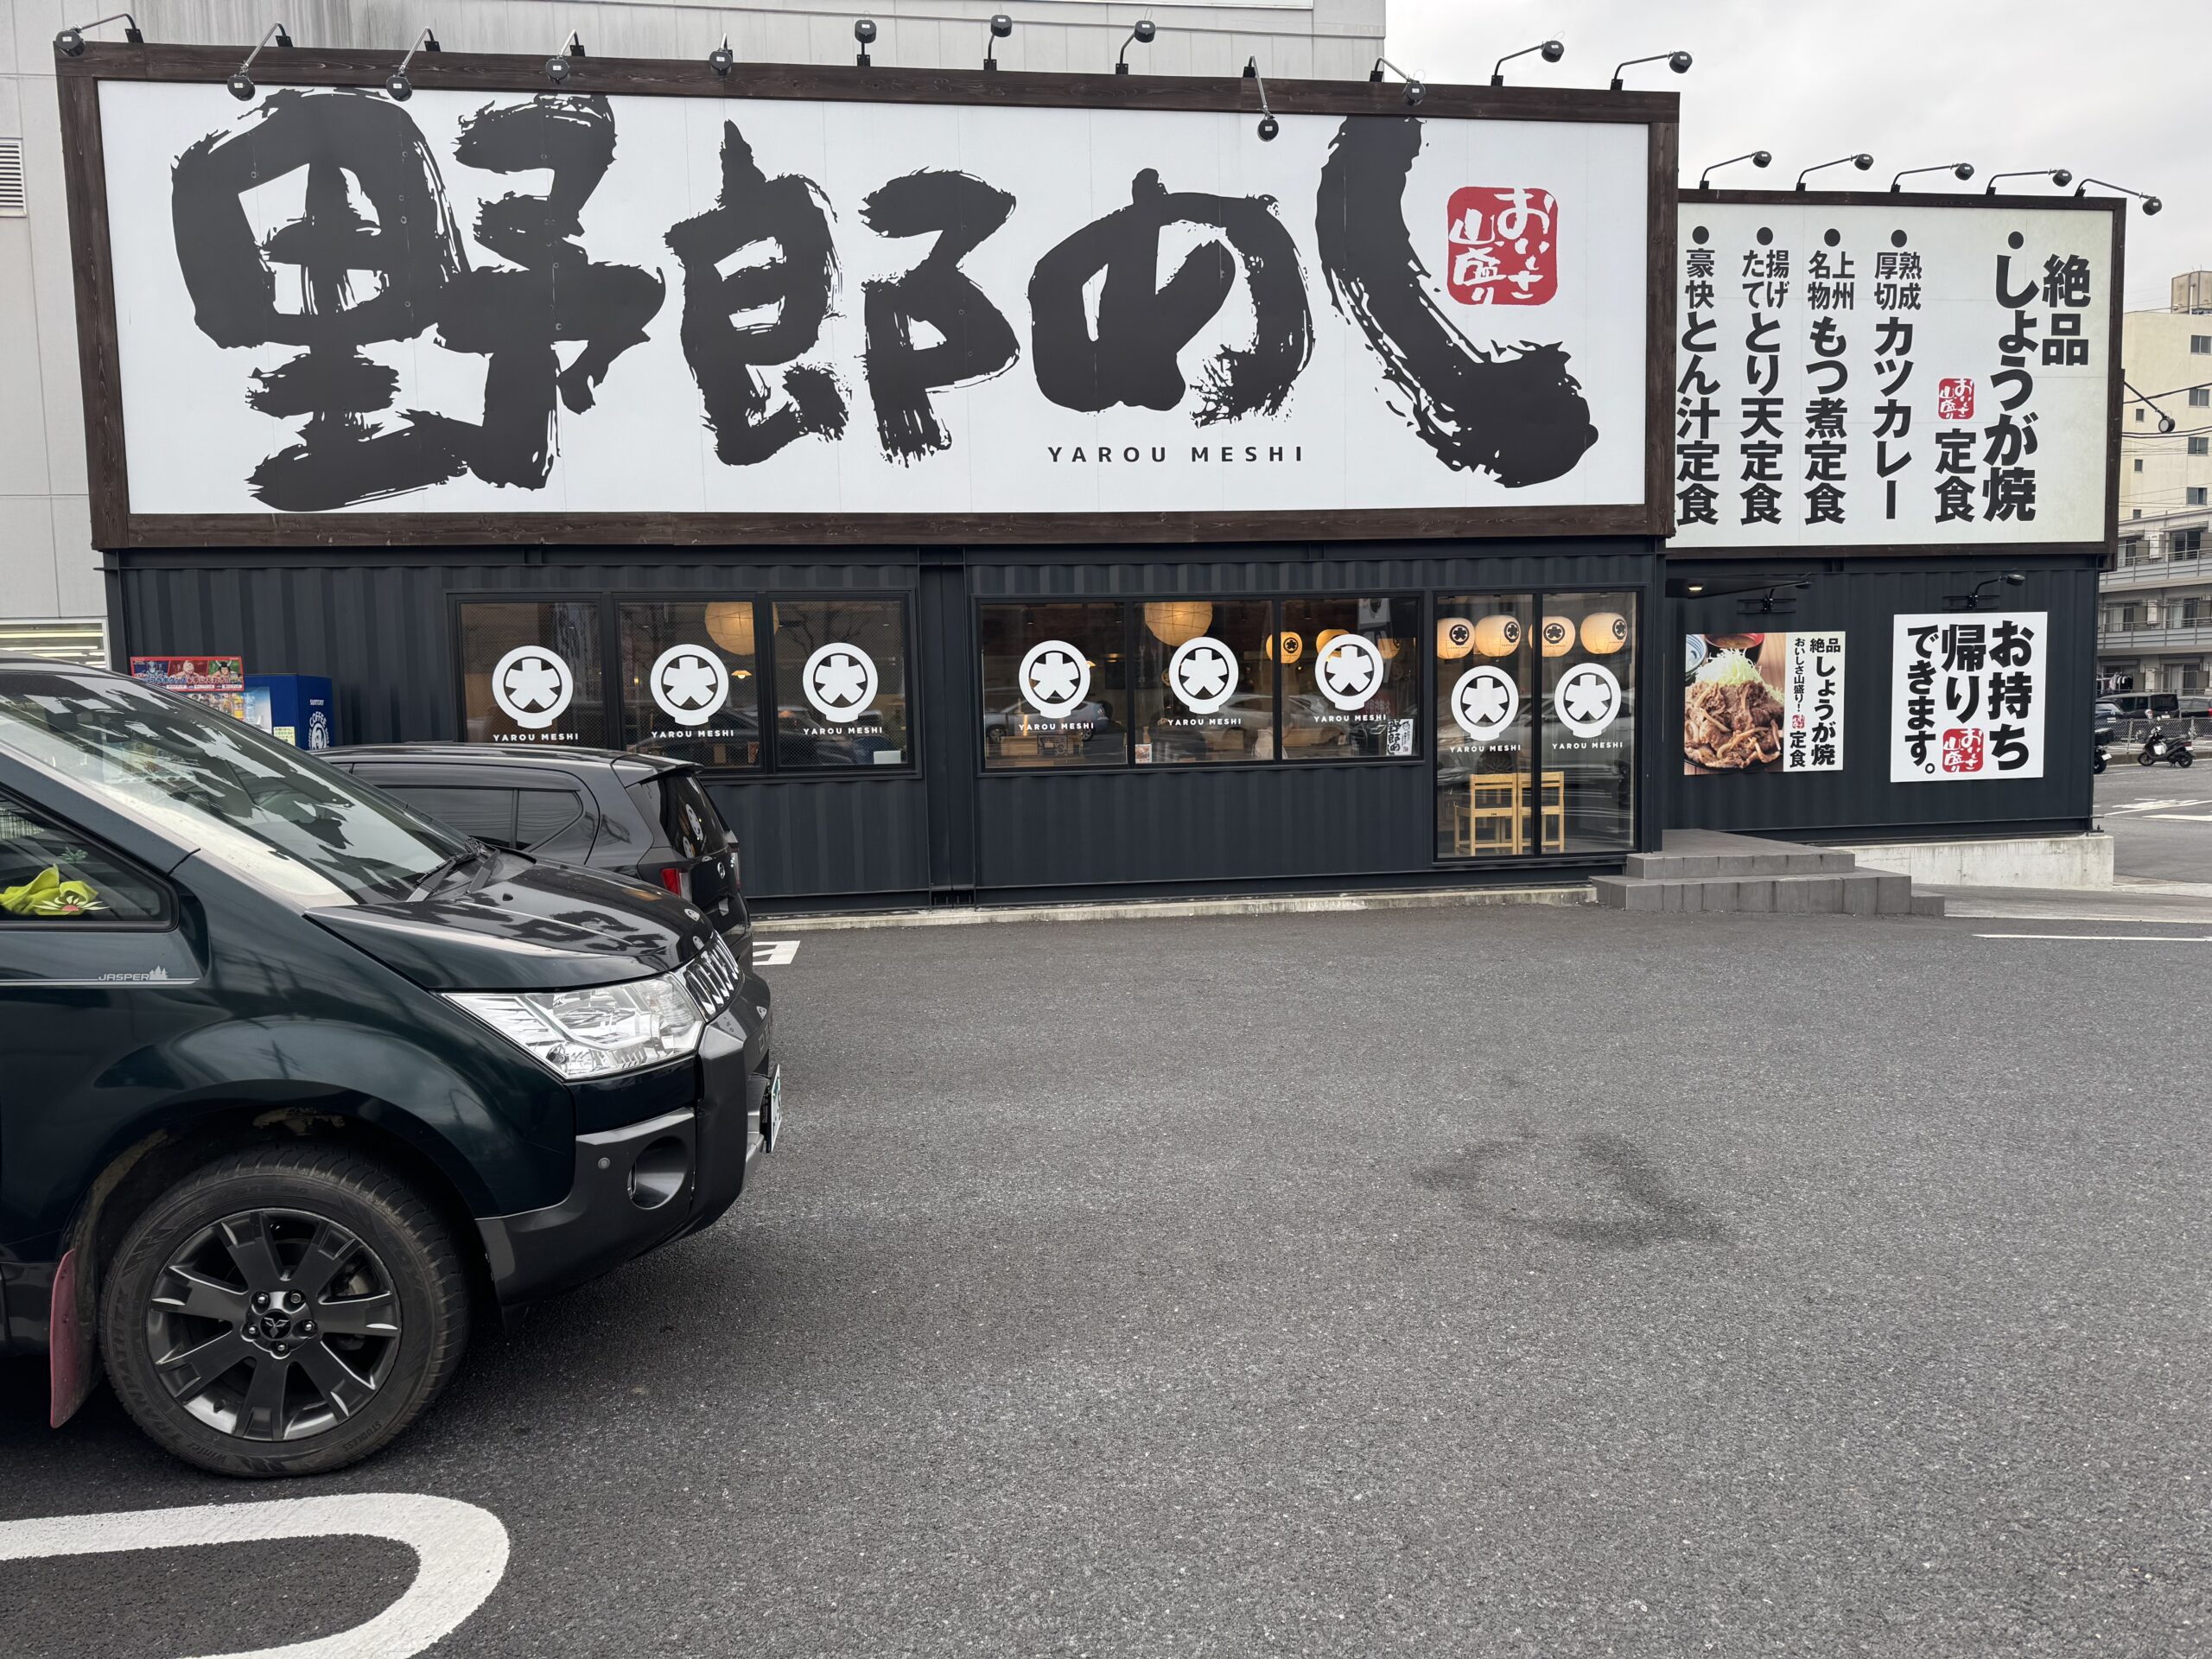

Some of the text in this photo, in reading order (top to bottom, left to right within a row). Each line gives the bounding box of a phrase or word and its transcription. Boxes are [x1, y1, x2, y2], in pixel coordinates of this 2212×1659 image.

[171, 87, 1599, 512] 野郎めし
[2043, 255, 2090, 365] 絶品
[1983, 255, 2039, 521] しょうが焼
[1049, 447, 1300, 461] YAROU MESHI
[1936, 429, 1976, 523] 定食
[1810, 639, 1840, 652] 絶品
[1942, 624, 1986, 724] 帰り
[309, 710, 327, 728] COFFEE
[1811, 657, 1835, 765] しょうが焼
[1905, 625, 1939, 774] できます。
[1988, 620, 2034, 770] お持ち
[1790, 731, 1806, 767] 定食
[186, 1442, 227, 1465] Winter
[342, 1421, 382, 1452] STUDLESS
